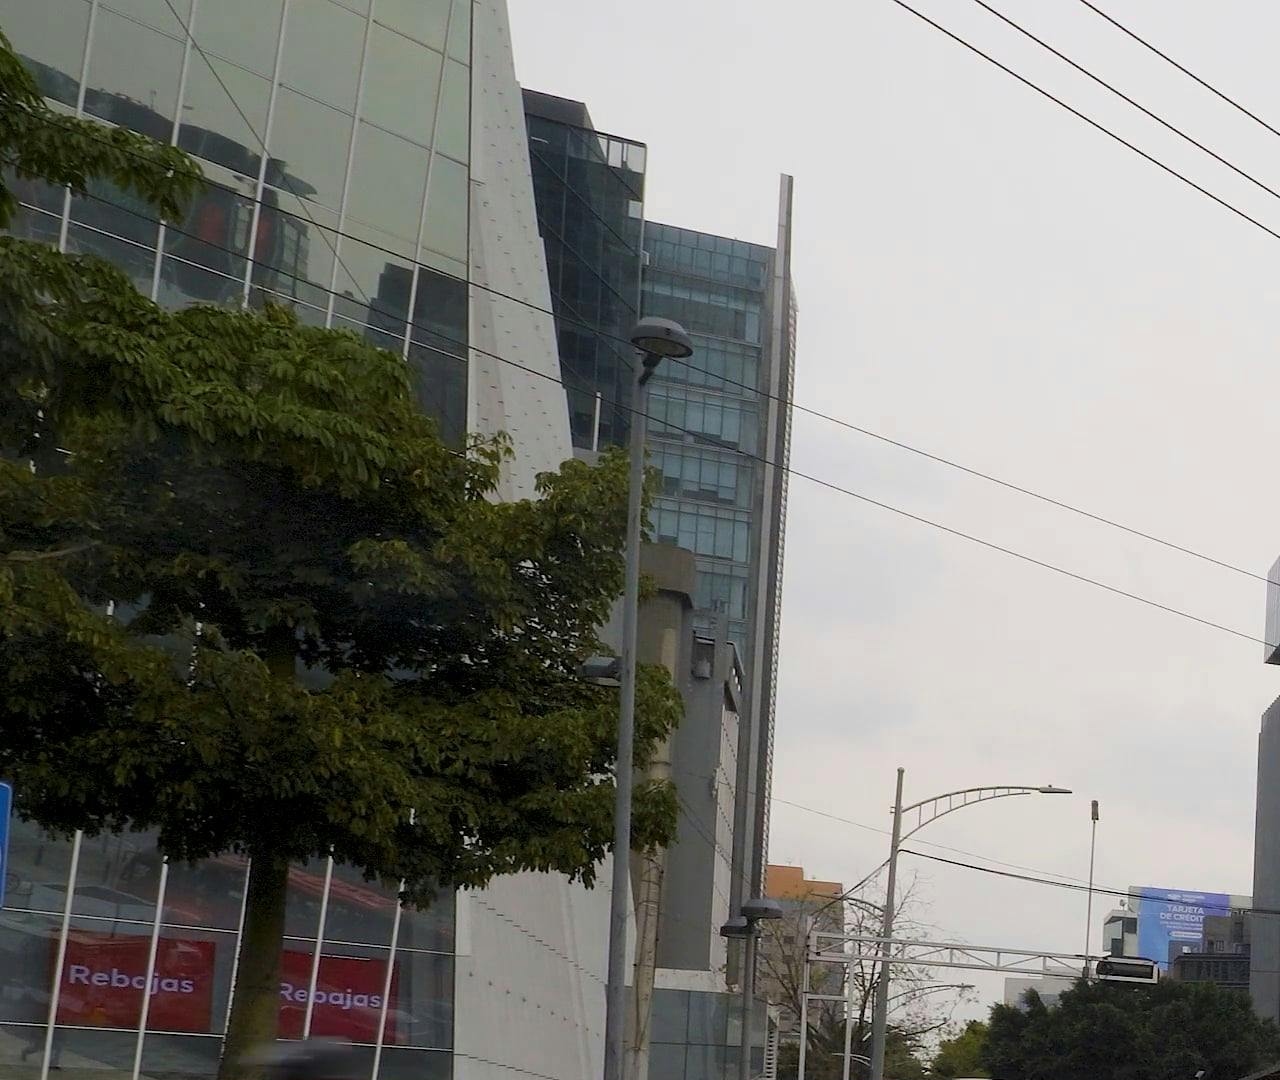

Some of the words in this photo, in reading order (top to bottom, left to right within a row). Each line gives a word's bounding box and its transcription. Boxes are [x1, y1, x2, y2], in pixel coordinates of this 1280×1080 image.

[1168, 904, 1204, 914] TARJETA
[1174, 912, 1204, 922] CRÉDIT
[70, 965, 194, 995] Rebajas
[280, 983, 382, 1010] Rebajas
